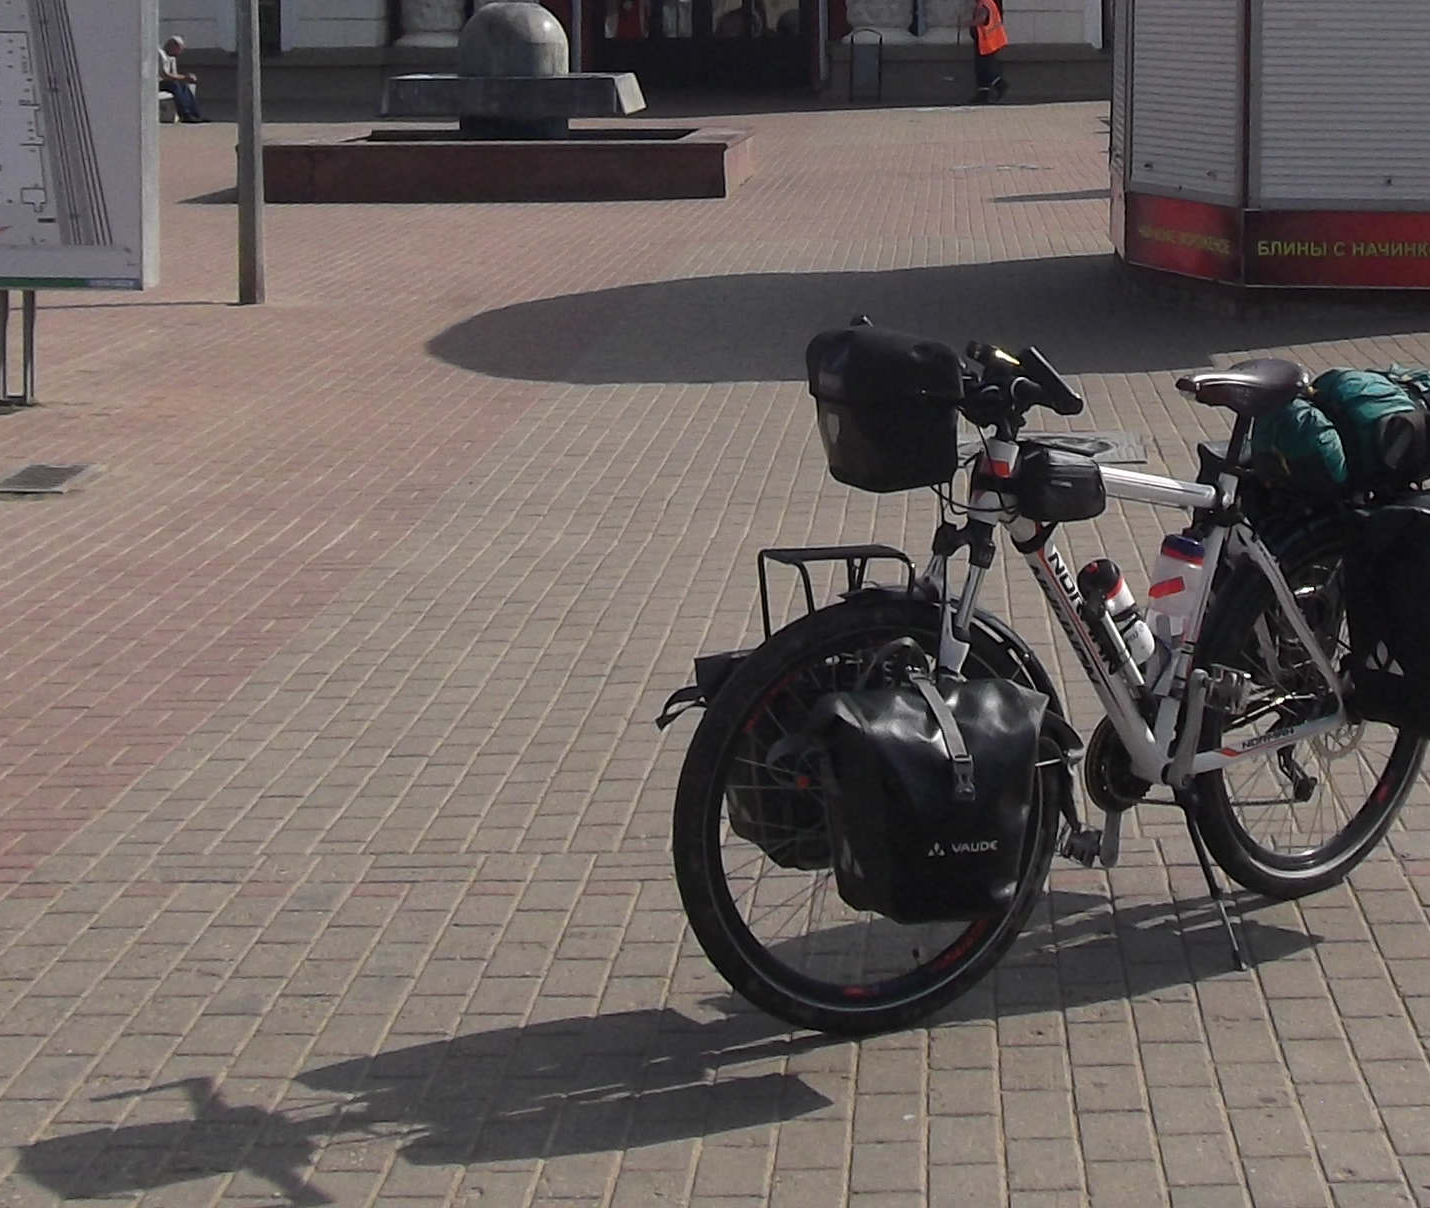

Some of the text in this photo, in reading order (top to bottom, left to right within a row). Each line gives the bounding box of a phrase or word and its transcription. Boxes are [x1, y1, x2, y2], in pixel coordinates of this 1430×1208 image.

[1257, 240, 1327, 257] БЛИНЫ
[1333, 241, 1346, 256] С
[951, 839, 999, 853] VAUDE
